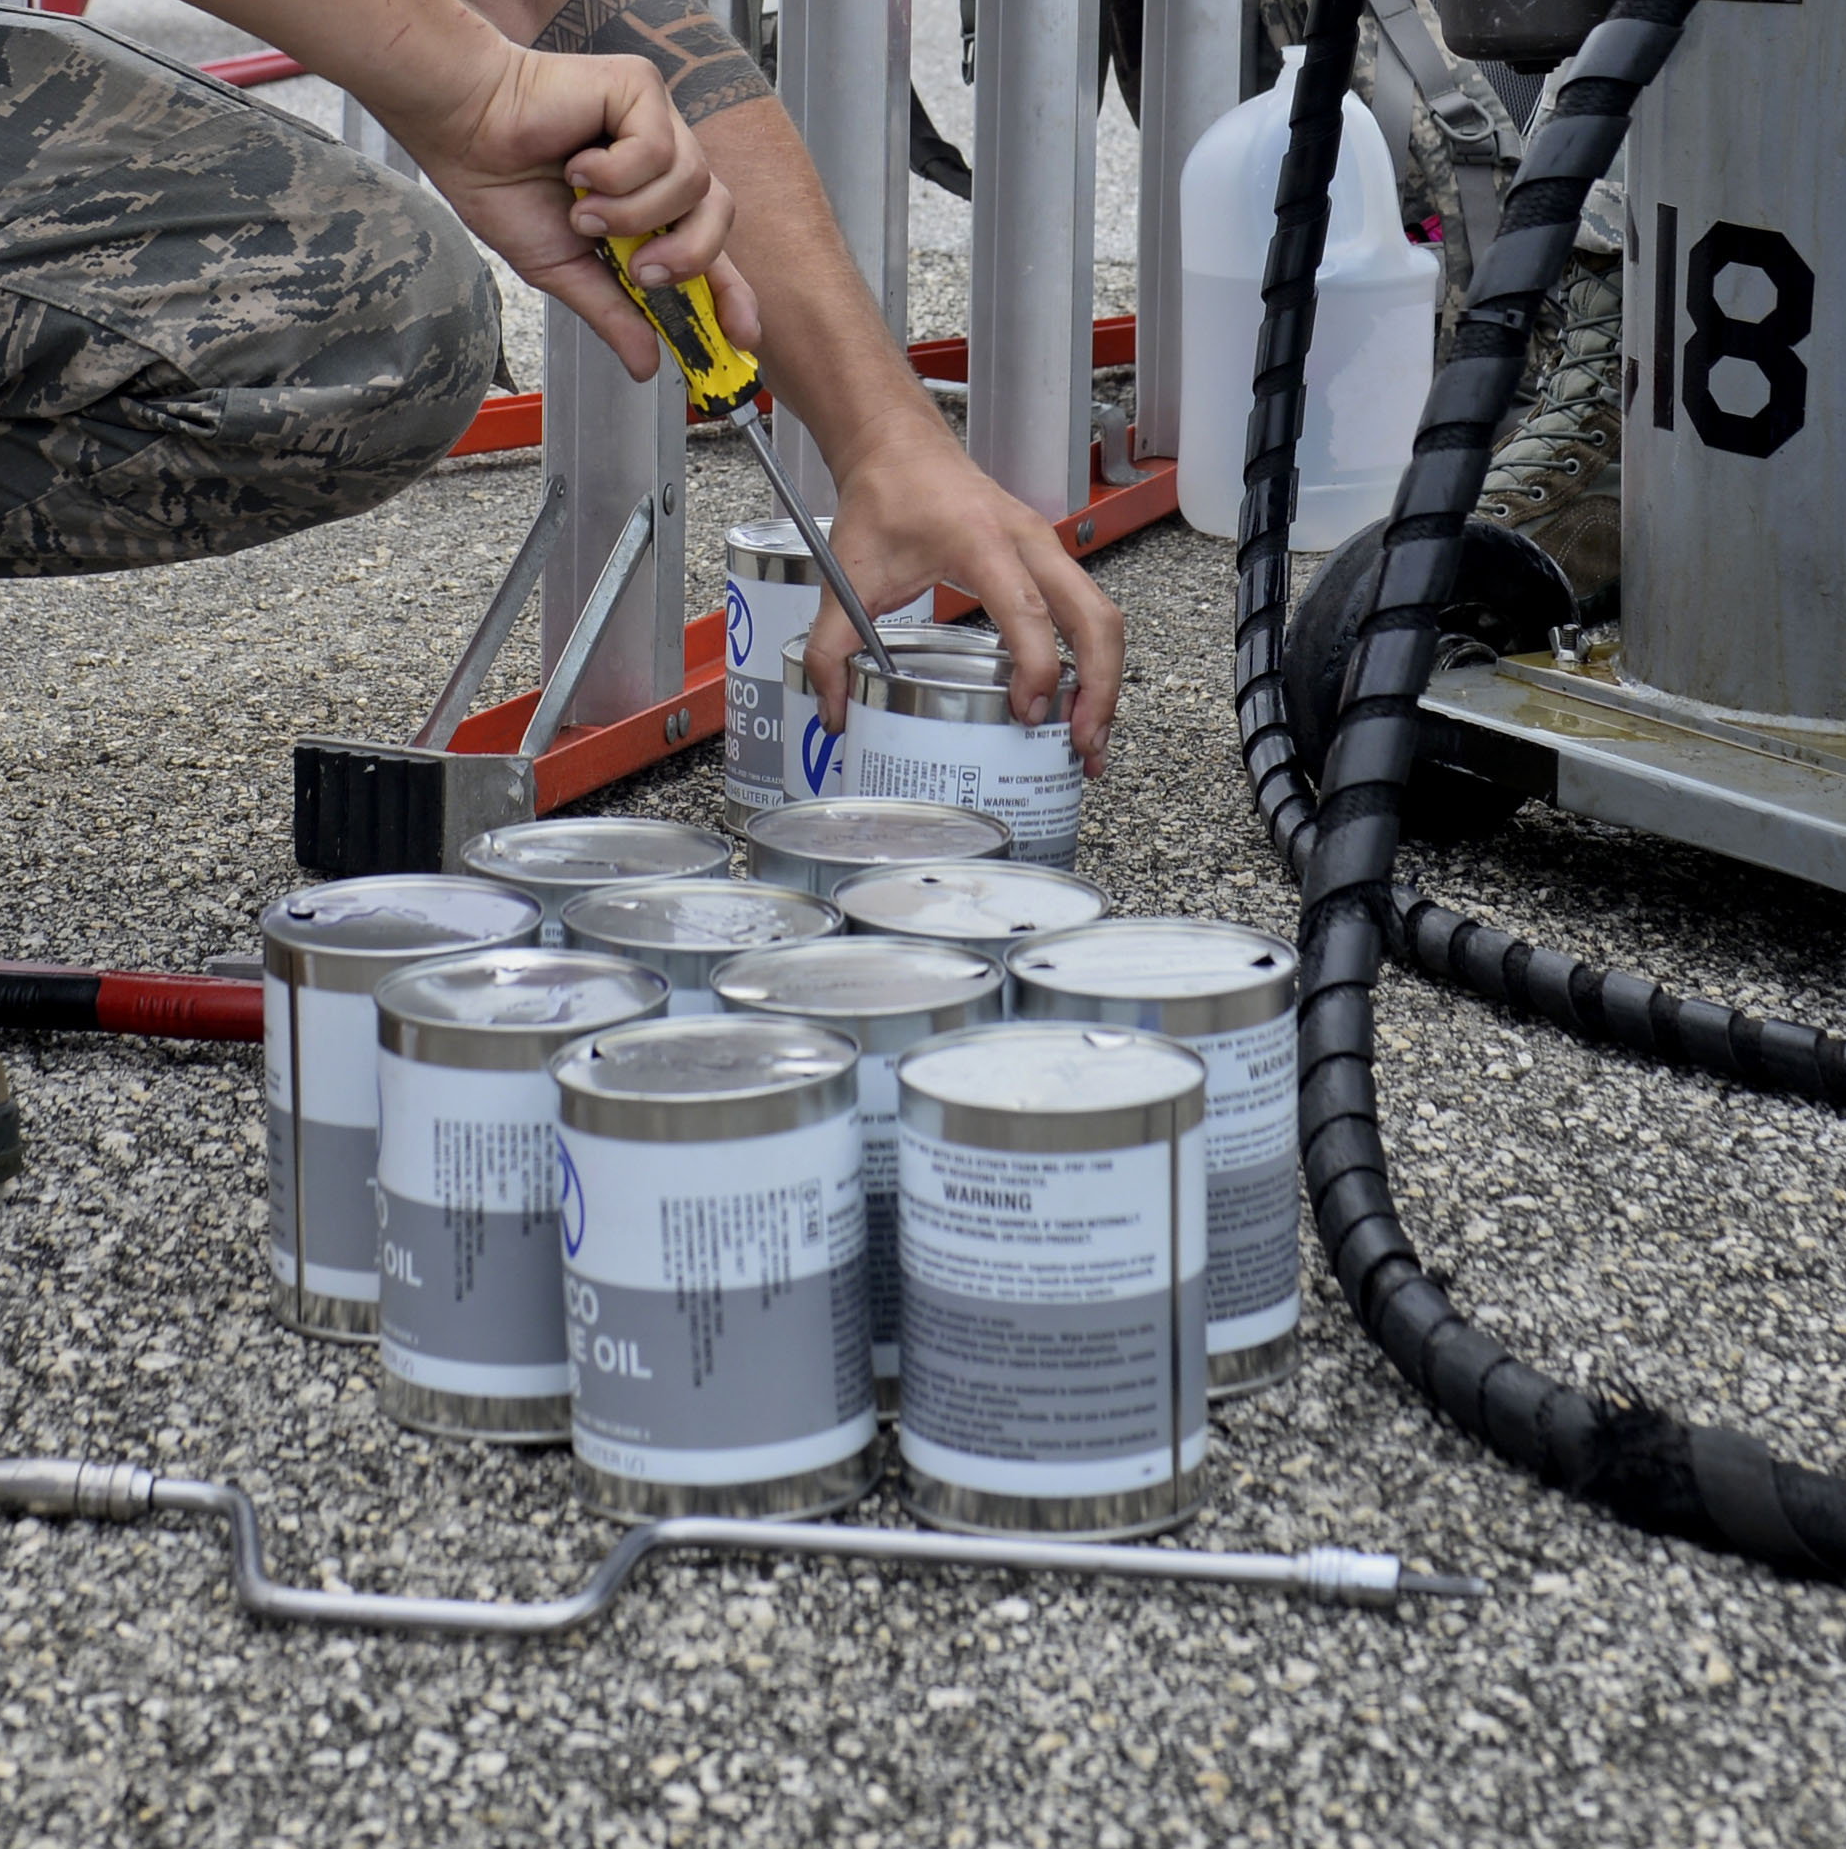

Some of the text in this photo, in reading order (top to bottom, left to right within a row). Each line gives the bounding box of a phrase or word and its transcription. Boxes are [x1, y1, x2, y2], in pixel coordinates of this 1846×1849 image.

[1015, 773, 1043, 785] CONTAIN
[983, 797, 1030, 808] WARNING!
[943, 1181, 1033, 1213] WARNING
[383, 1240, 424, 1288] OIL
[593, 1334, 654, 1380] OIL
